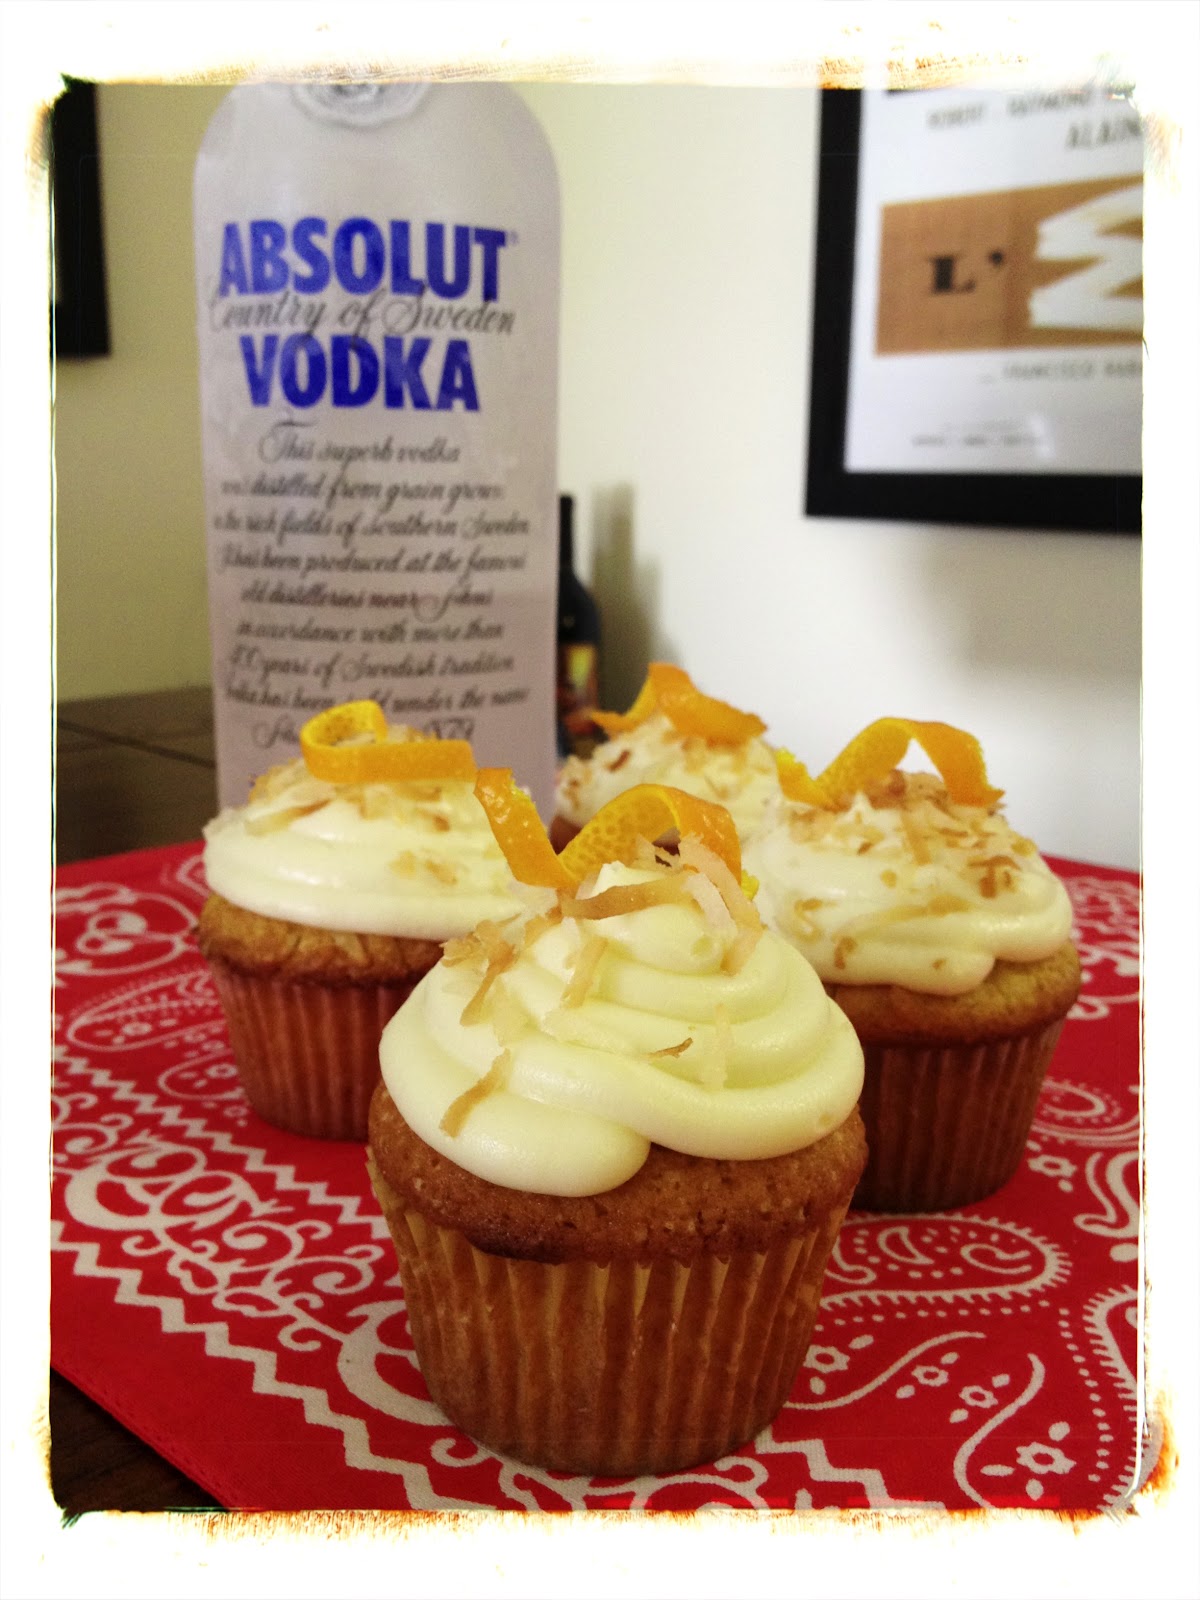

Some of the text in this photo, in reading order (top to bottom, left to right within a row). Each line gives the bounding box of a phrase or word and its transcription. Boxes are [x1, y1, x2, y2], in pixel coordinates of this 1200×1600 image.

[219, 216, 506, 303] ABSOLUT
[207, 283, 517, 350] Country of Sweden
[239, 334, 480, 413] VODKA
[396, 436, 461, 464] vodka
